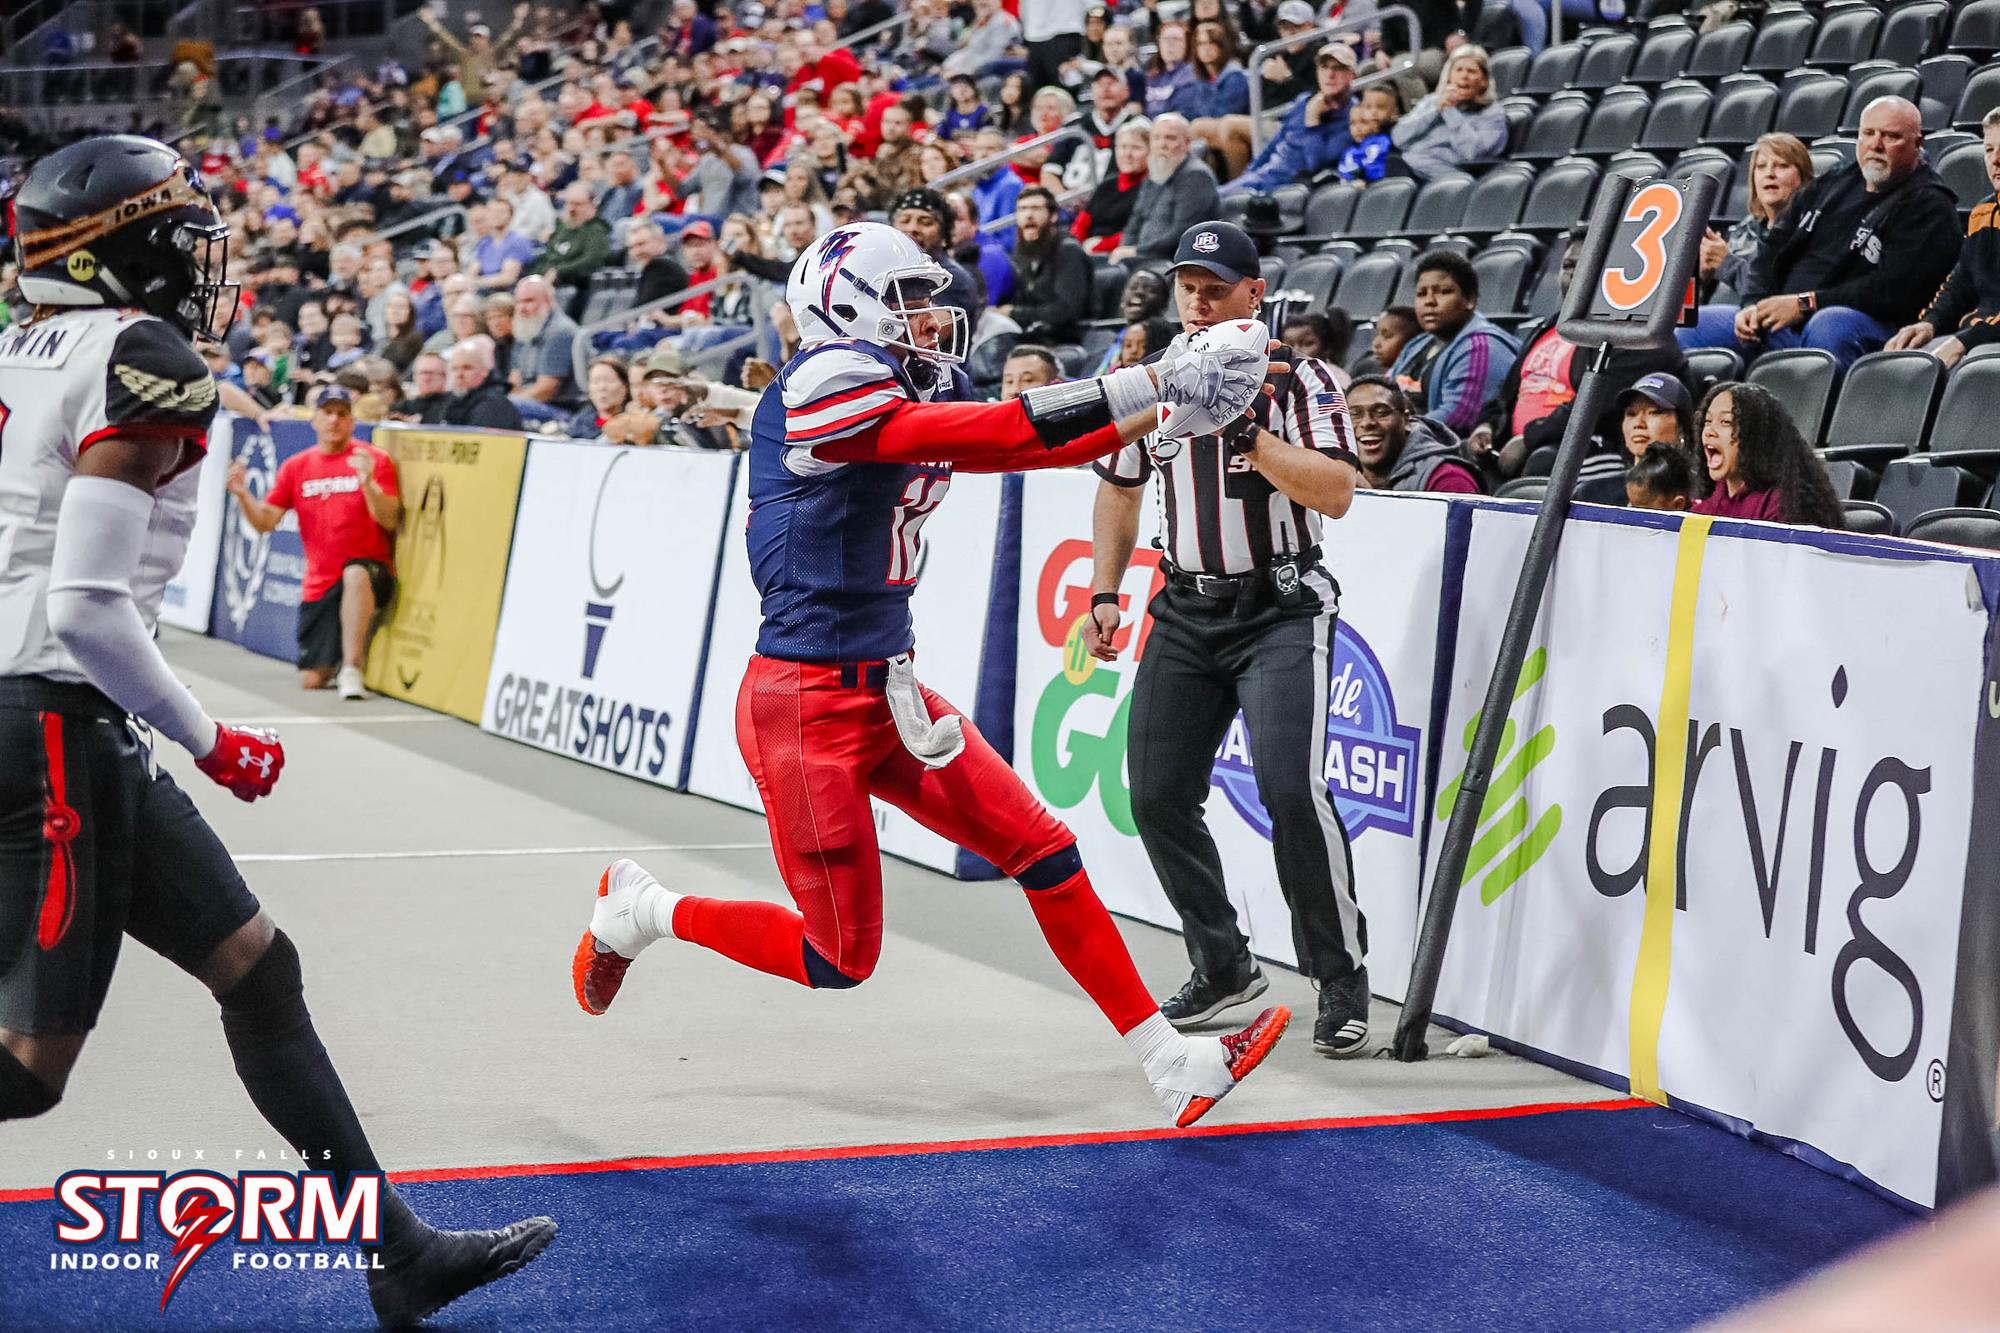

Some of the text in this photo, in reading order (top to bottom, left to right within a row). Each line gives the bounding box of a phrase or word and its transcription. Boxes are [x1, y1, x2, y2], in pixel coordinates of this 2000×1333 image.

[114, 188, 172, 222] IOWA
[70, 257, 94, 271] JP
[1602, 183, 1683, 310] 3
[0, 327, 68, 359] WIN
[1227, 455, 1257, 473] S
[494, 673, 671, 777] GREATSHOTS
[1324, 740, 1406, 803] ASH
[1585, 664, 1932, 1082] arvig
